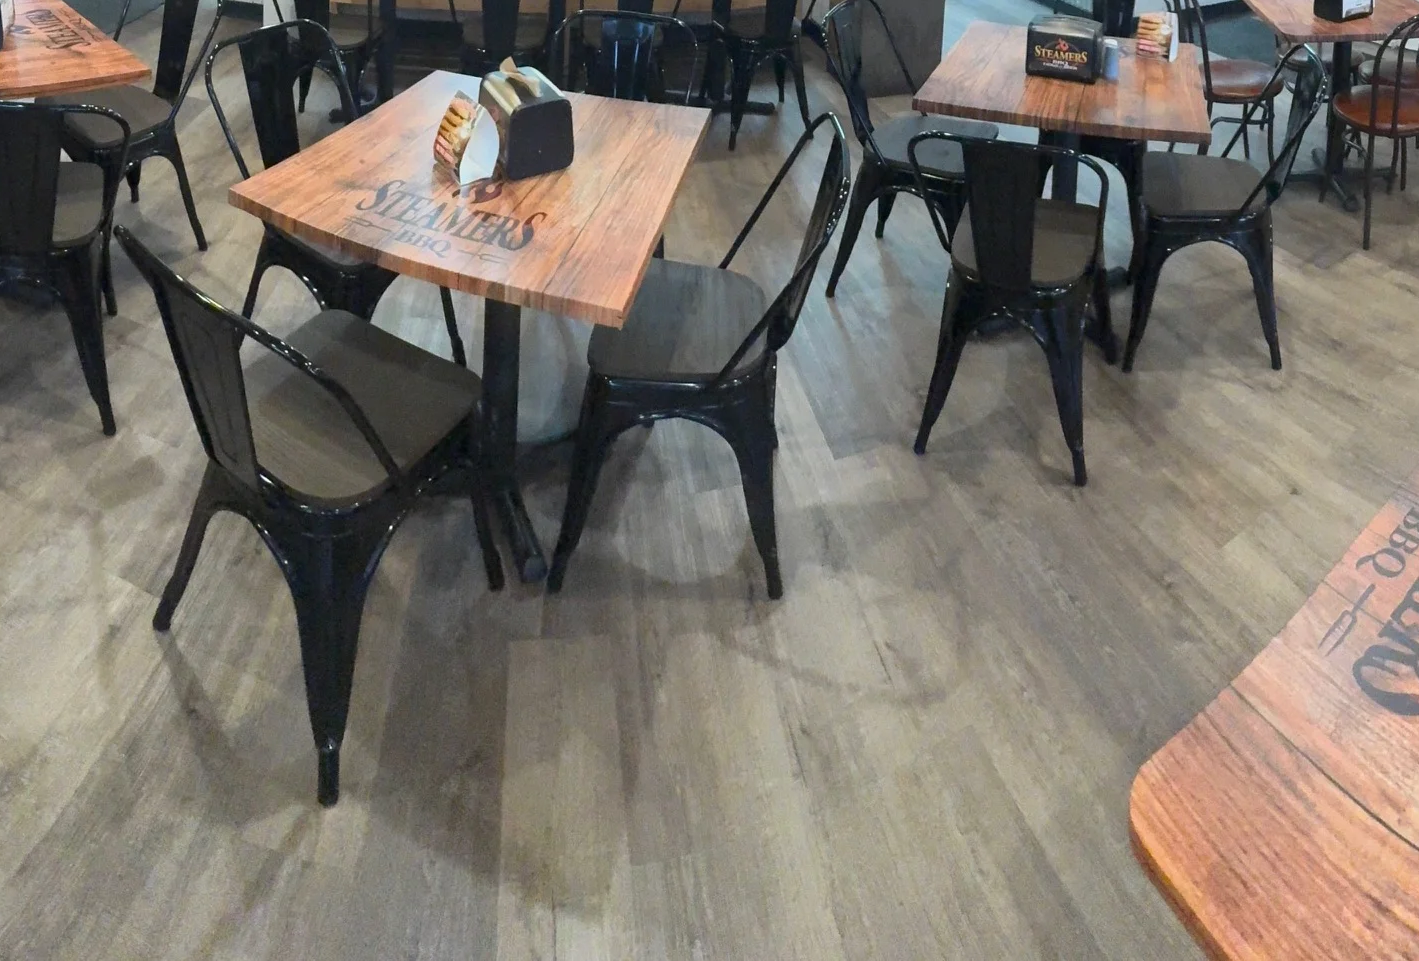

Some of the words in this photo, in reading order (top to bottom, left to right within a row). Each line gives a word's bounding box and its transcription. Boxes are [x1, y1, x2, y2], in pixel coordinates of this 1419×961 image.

[1035, 44, 1088, 64] STEAMERS
[355, 179, 548, 252] STEAMERS
[394, 228, 452, 259] BBQ
